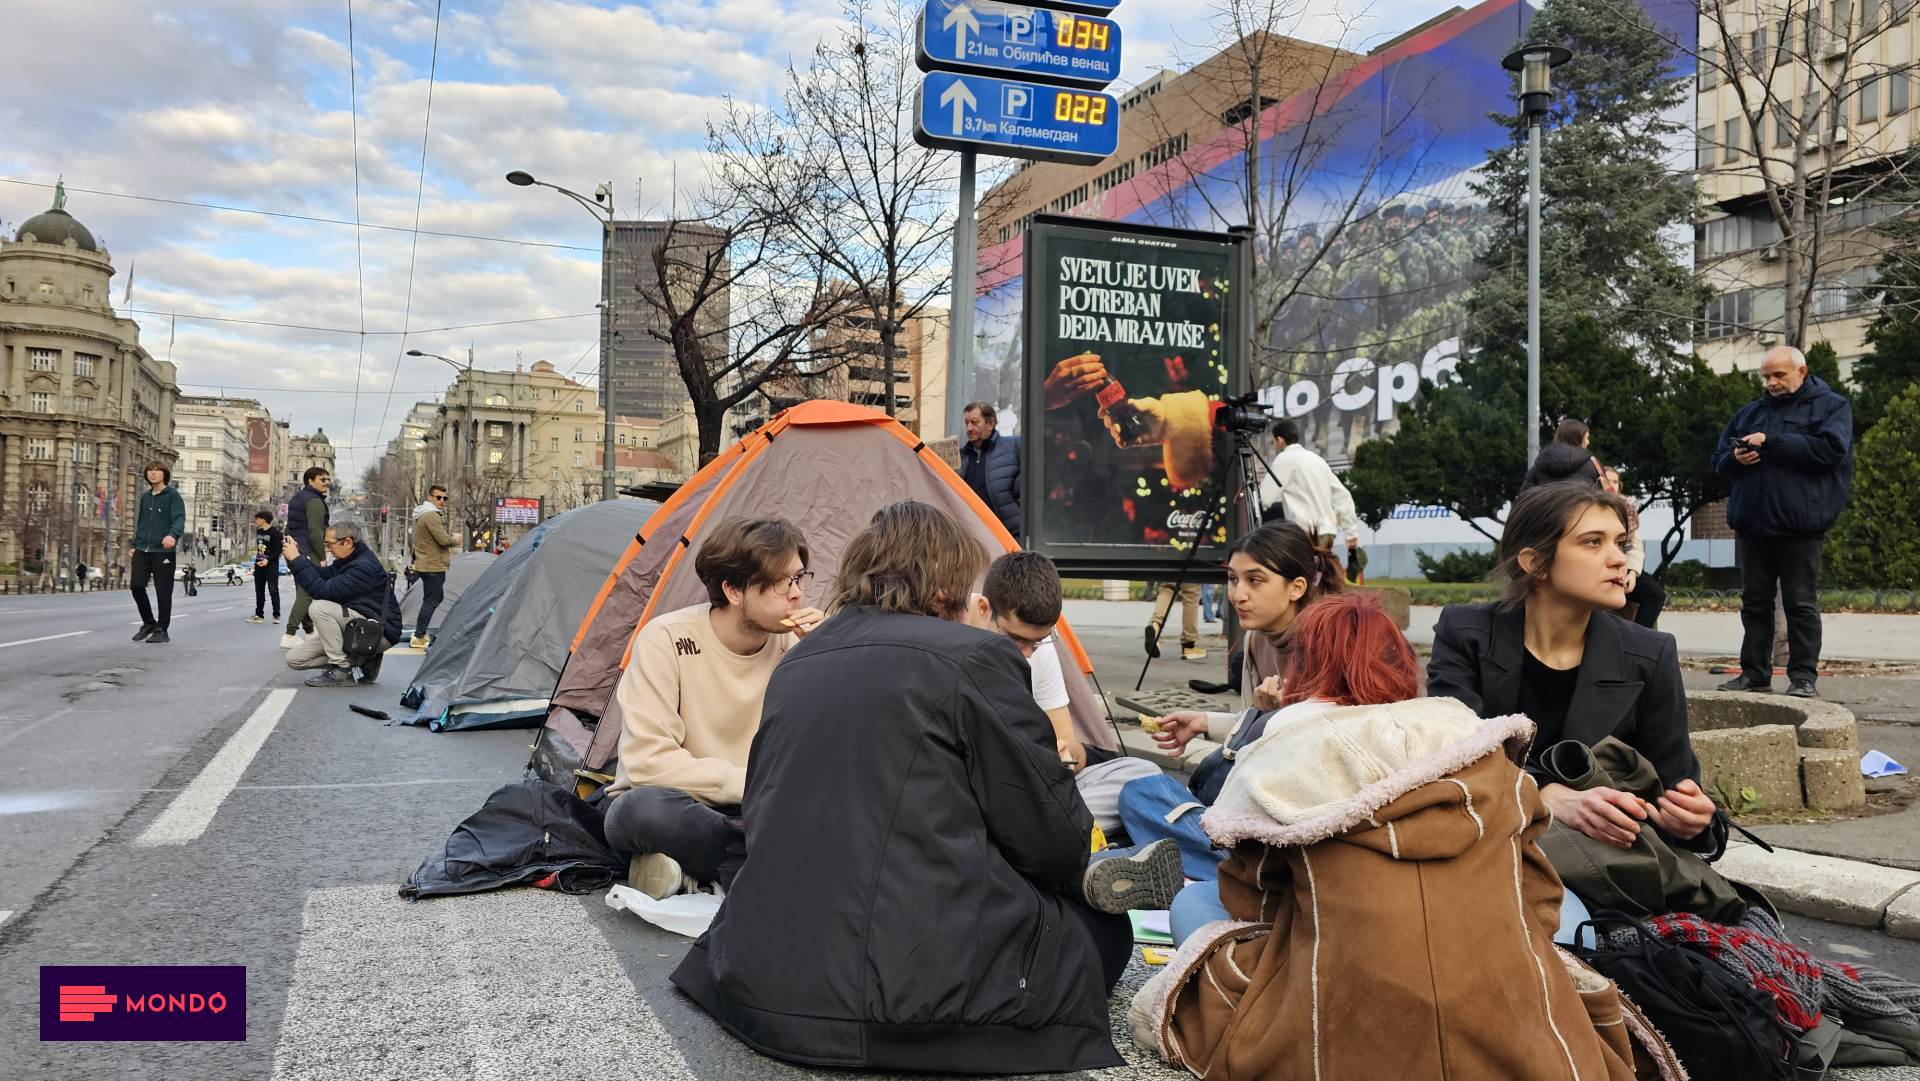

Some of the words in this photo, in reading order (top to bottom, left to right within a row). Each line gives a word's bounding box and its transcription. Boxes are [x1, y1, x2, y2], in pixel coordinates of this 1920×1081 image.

[1011, 15, 1031, 42] P
[1057, 18, 1109, 51] 034
[1002, 46, 1068, 67] Обилићев
[1072, 57, 1110, 74] венац
[1007, 88, 1028, 115] P
[1055, 93, 1106, 125] 022
[1000, 121, 1078, 143] Калемегдан
[1110, 236, 1136, 244] ALMA
[1137, 239, 1177, 248] QUATTRO
[1060, 256, 1121, 286] SVETU
[1123, 262, 1147, 288] JE
[1150, 265, 1201, 293] UVEK
[1059, 285, 1161, 317] POTREBAN
[1058, 314, 1112, 342] DEDA
[1115, 318, 1164, 345] MRAZ
[1166, 320, 1205, 349] VIŠE
